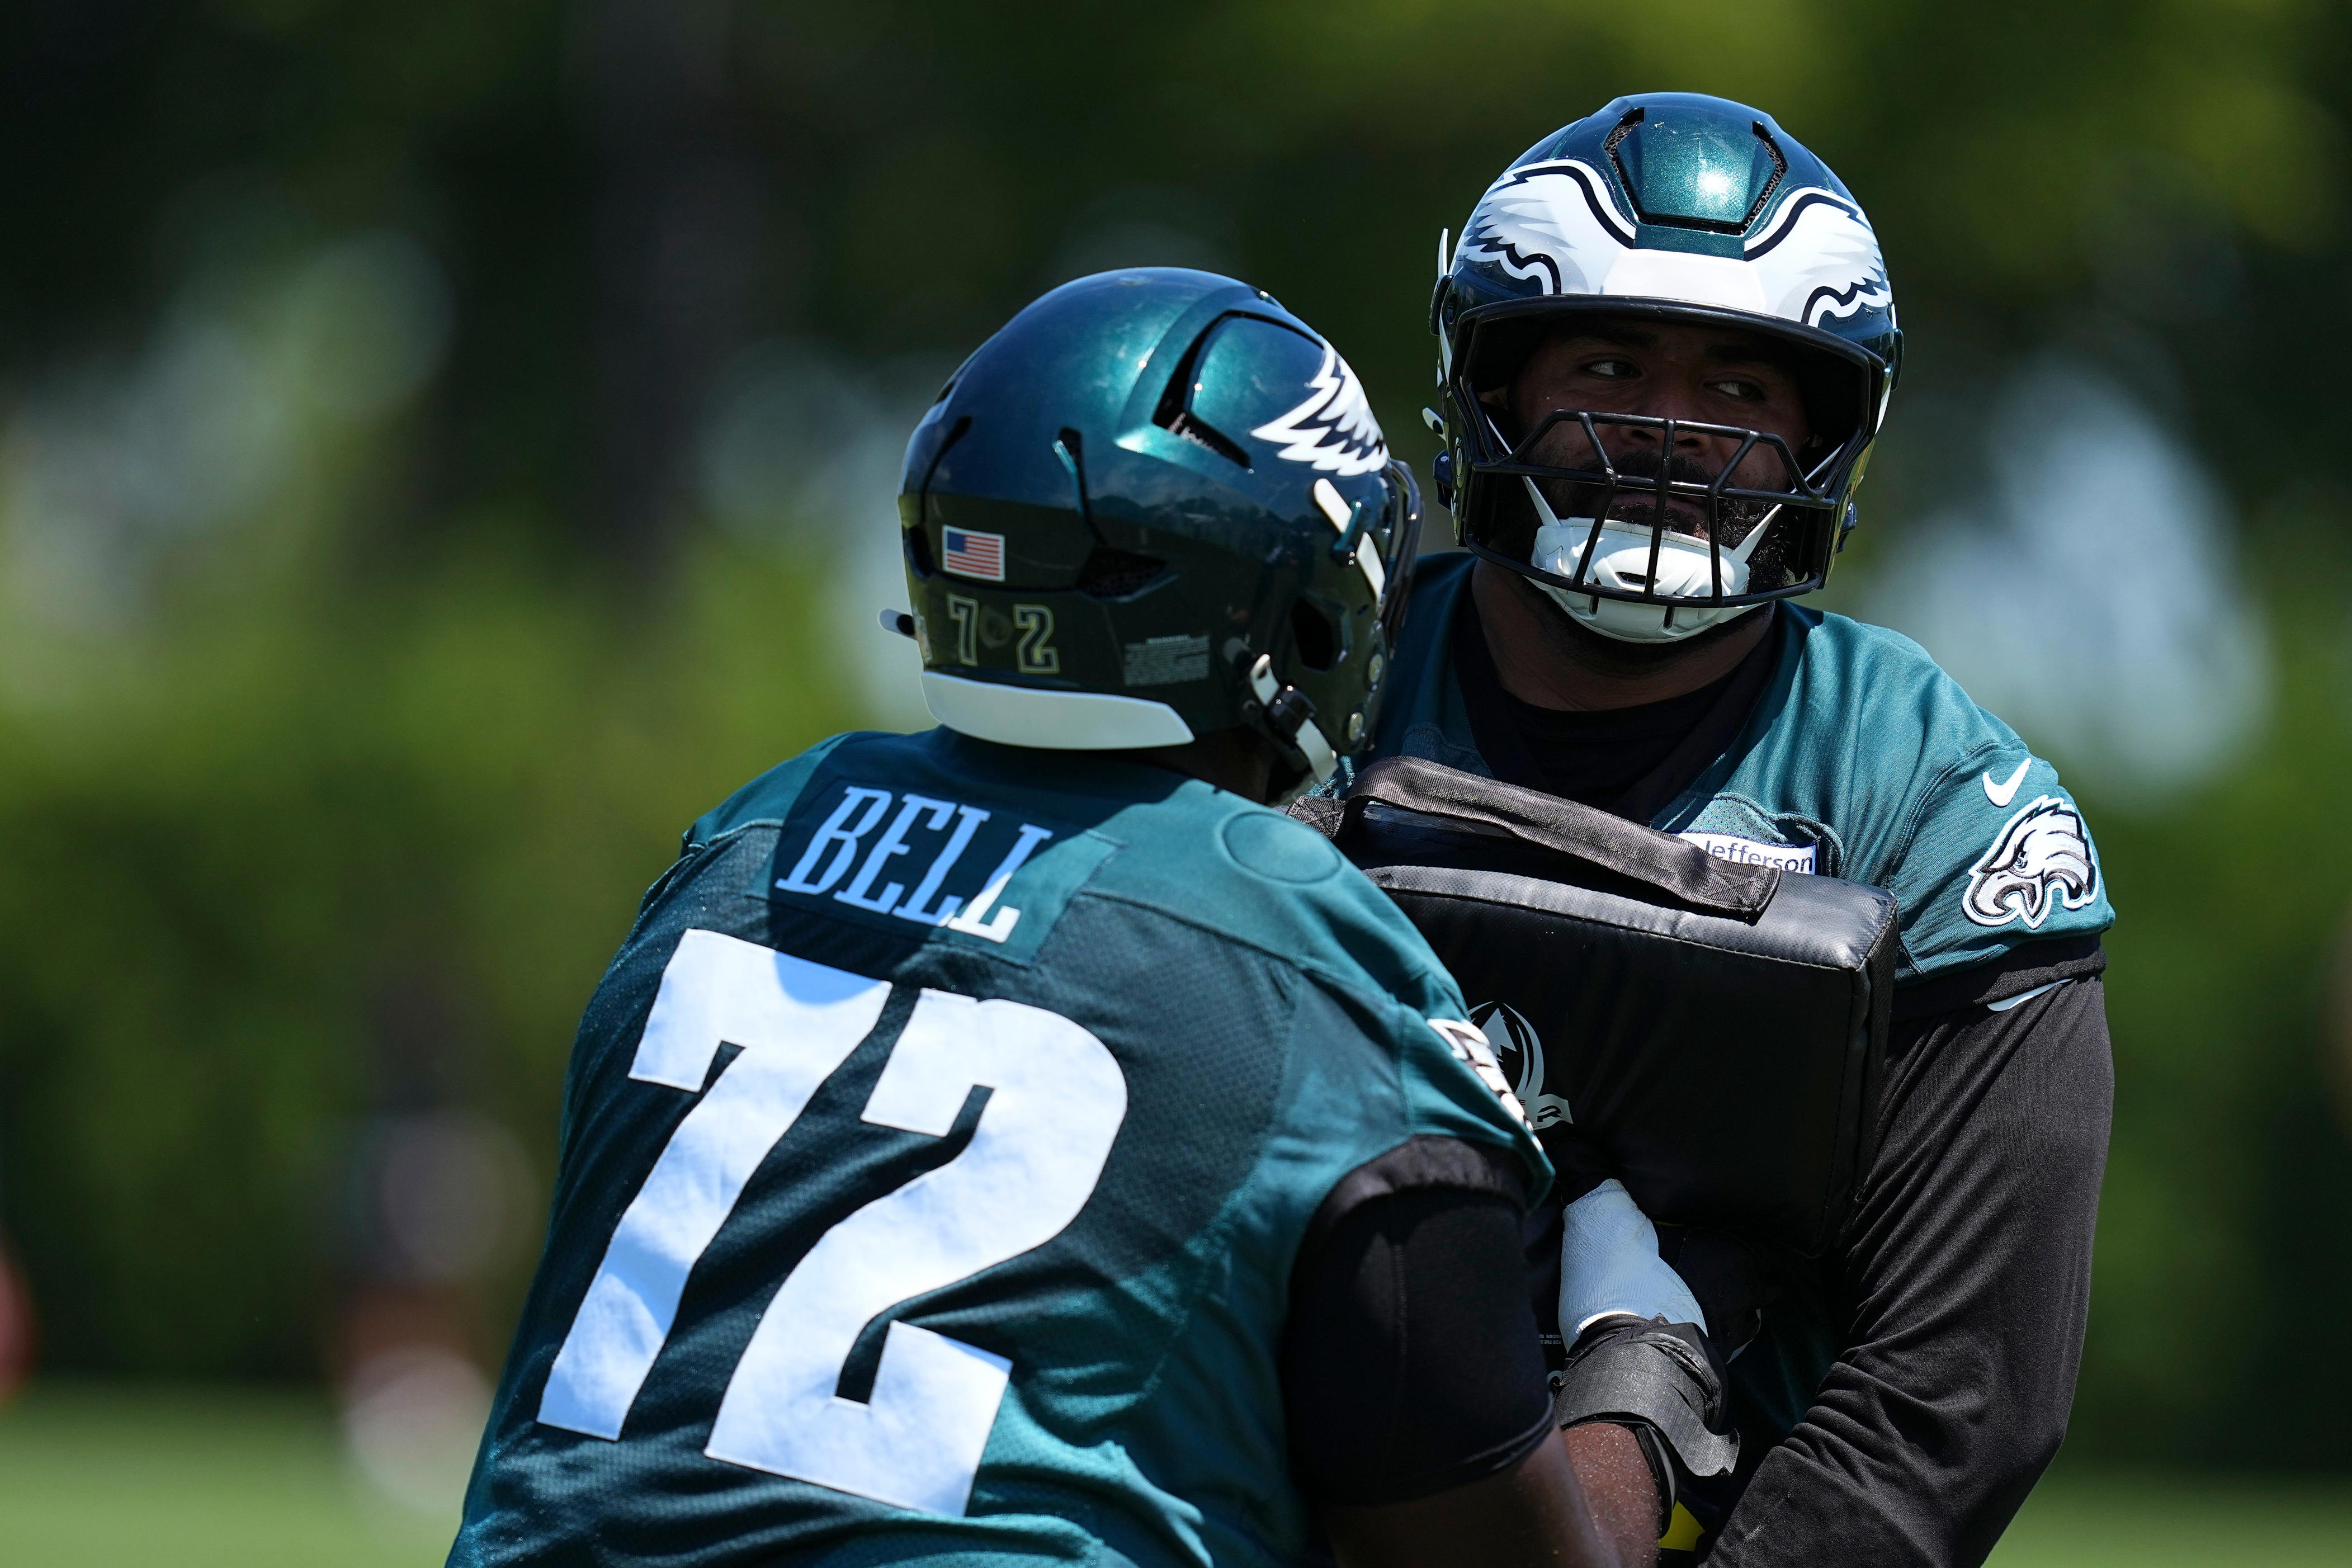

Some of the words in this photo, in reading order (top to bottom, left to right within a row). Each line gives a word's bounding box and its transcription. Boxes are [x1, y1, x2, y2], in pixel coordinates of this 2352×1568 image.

[947, 593, 1060, 674] 72
[775, 786, 1054, 943] BELL
[536, 929, 1128, 1518] 72
